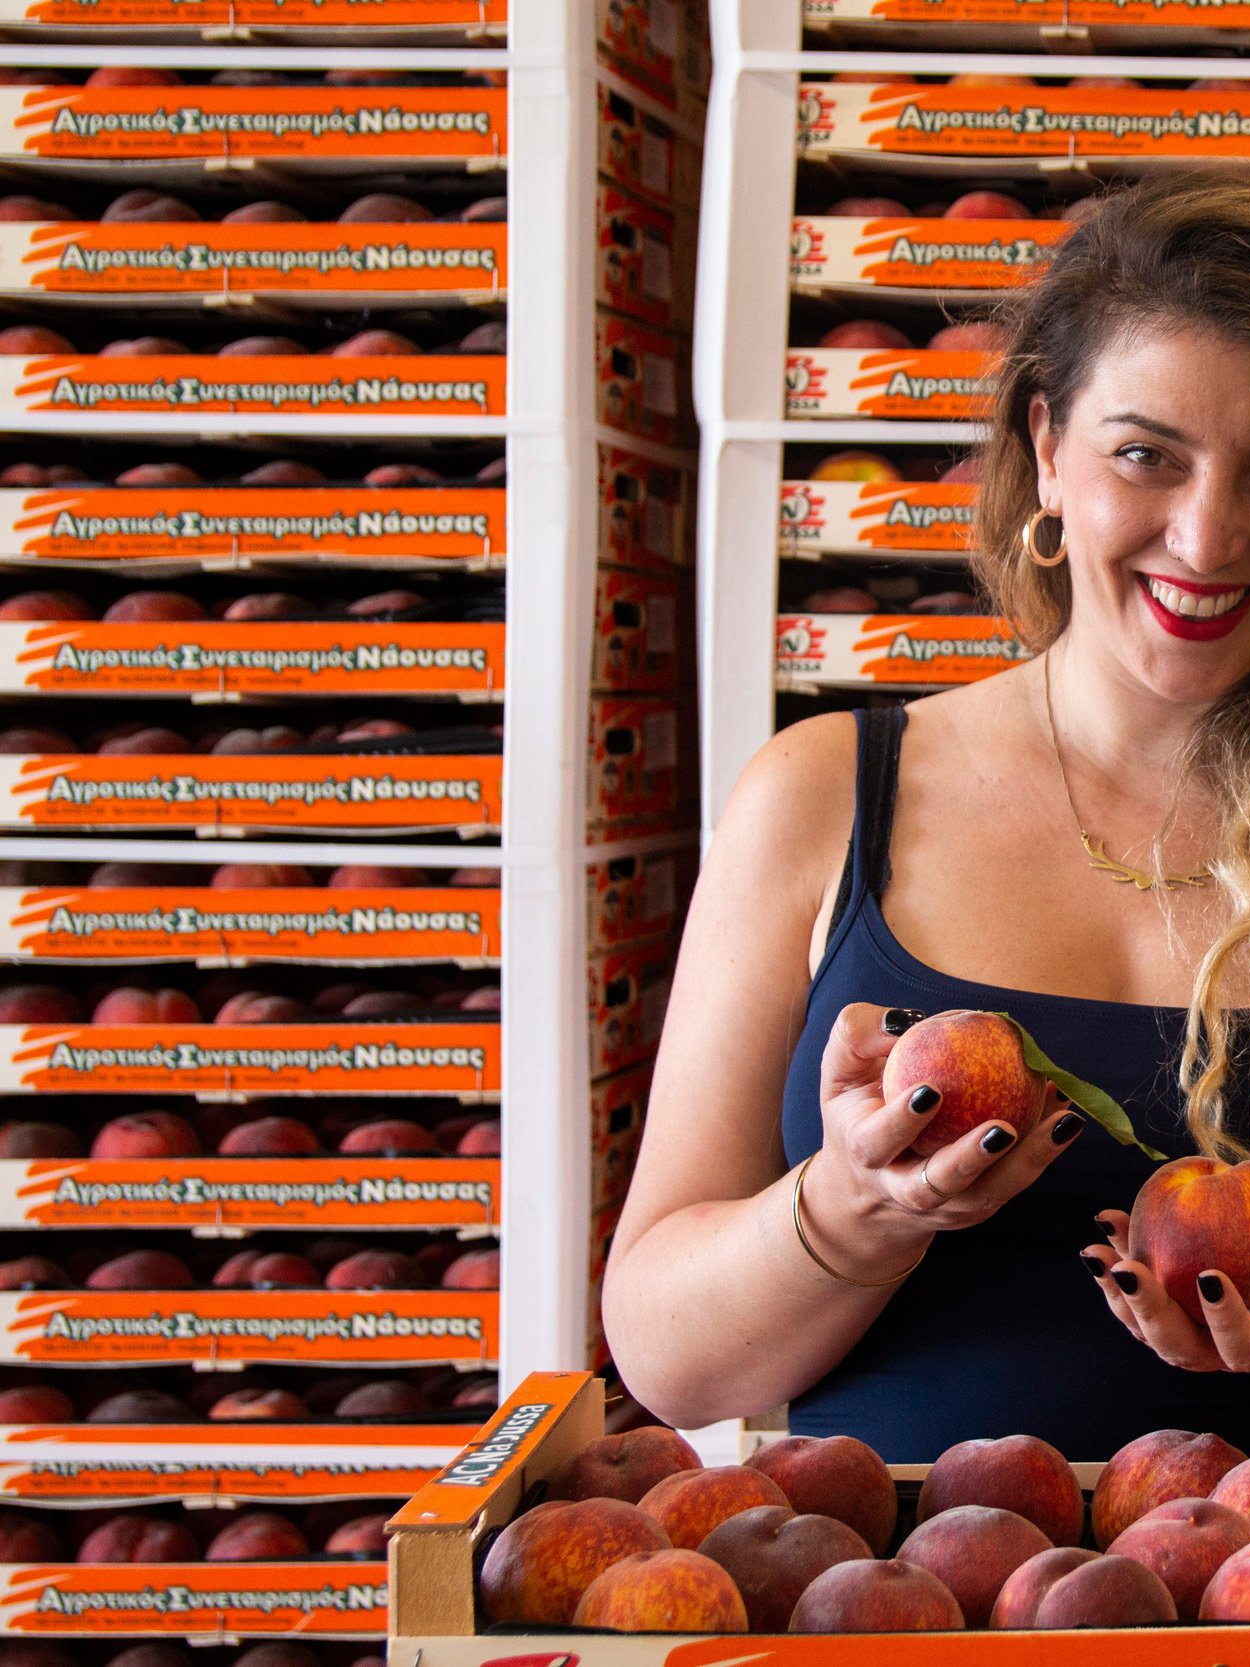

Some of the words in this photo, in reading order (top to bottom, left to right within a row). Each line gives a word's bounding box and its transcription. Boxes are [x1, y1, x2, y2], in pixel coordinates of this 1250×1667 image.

[52, 108, 179, 137] Αγροτικός
[180, 108, 357, 136] Συνεταιρισμός
[358, 107, 488, 134] Νάουσας
[899, 107, 1023, 133] Αγροτικός
[1024, 108, 1197, 138] Συνεταιρισμός
[61, 245, 187, 273] Αγροτικός
[188, 245, 364, 273] Συνεταιρισμός
[364, 244, 494, 271] Νάουσας
[889, 236, 1016, 265] Αγροτικός
[52, 378, 178, 406] Αγροτικός
[179, 378, 356, 407] Συνεταιρισμός
[356, 377, 486, 404] Νάουσας
[50, 512, 177, 540] Αγροτικός
[178, 512, 355, 540] Συνεταιρισμός
[356, 510, 486, 537] Νάουσας
[53, 644, 179, 673] Αγροτικός
[179, 644, 355, 673] Συνεταιρισμός
[356, 644, 485, 672] Νάουσας
[47, 776, 173, 805] Αγροτικός
[174, 776, 350, 805] Συνεταιρισμός
[350, 775, 480, 802] Νάουσας
[48, 908, 174, 936] Αγροτικός
[175, 907, 351, 936] Συνεταιρισμός
[351, 907, 481, 935] Νάουσας
[50, 1044, 176, 1072] Αγροτικός
[177, 1043, 354, 1072] Συνεταιρισμός
[354, 1043, 484, 1071] Νάουσας
[53, 1177, 180, 1207] Αγροτικός
[181, 1177, 360, 1206] Συνεταιρισμός
[360, 1177, 491, 1207] Νάουσας
[43, 1312, 170, 1342] Αγροτικός
[171, 1312, 350, 1341] Συνεταιρισμός
[350, 1312, 481, 1340] Νάουσας
[438, 1403, 554, 1487] ACNaoussa
[36, 1586, 167, 1616] Αγροτικός
[168, 1586, 347, 1617] Συνεταιρισμός
